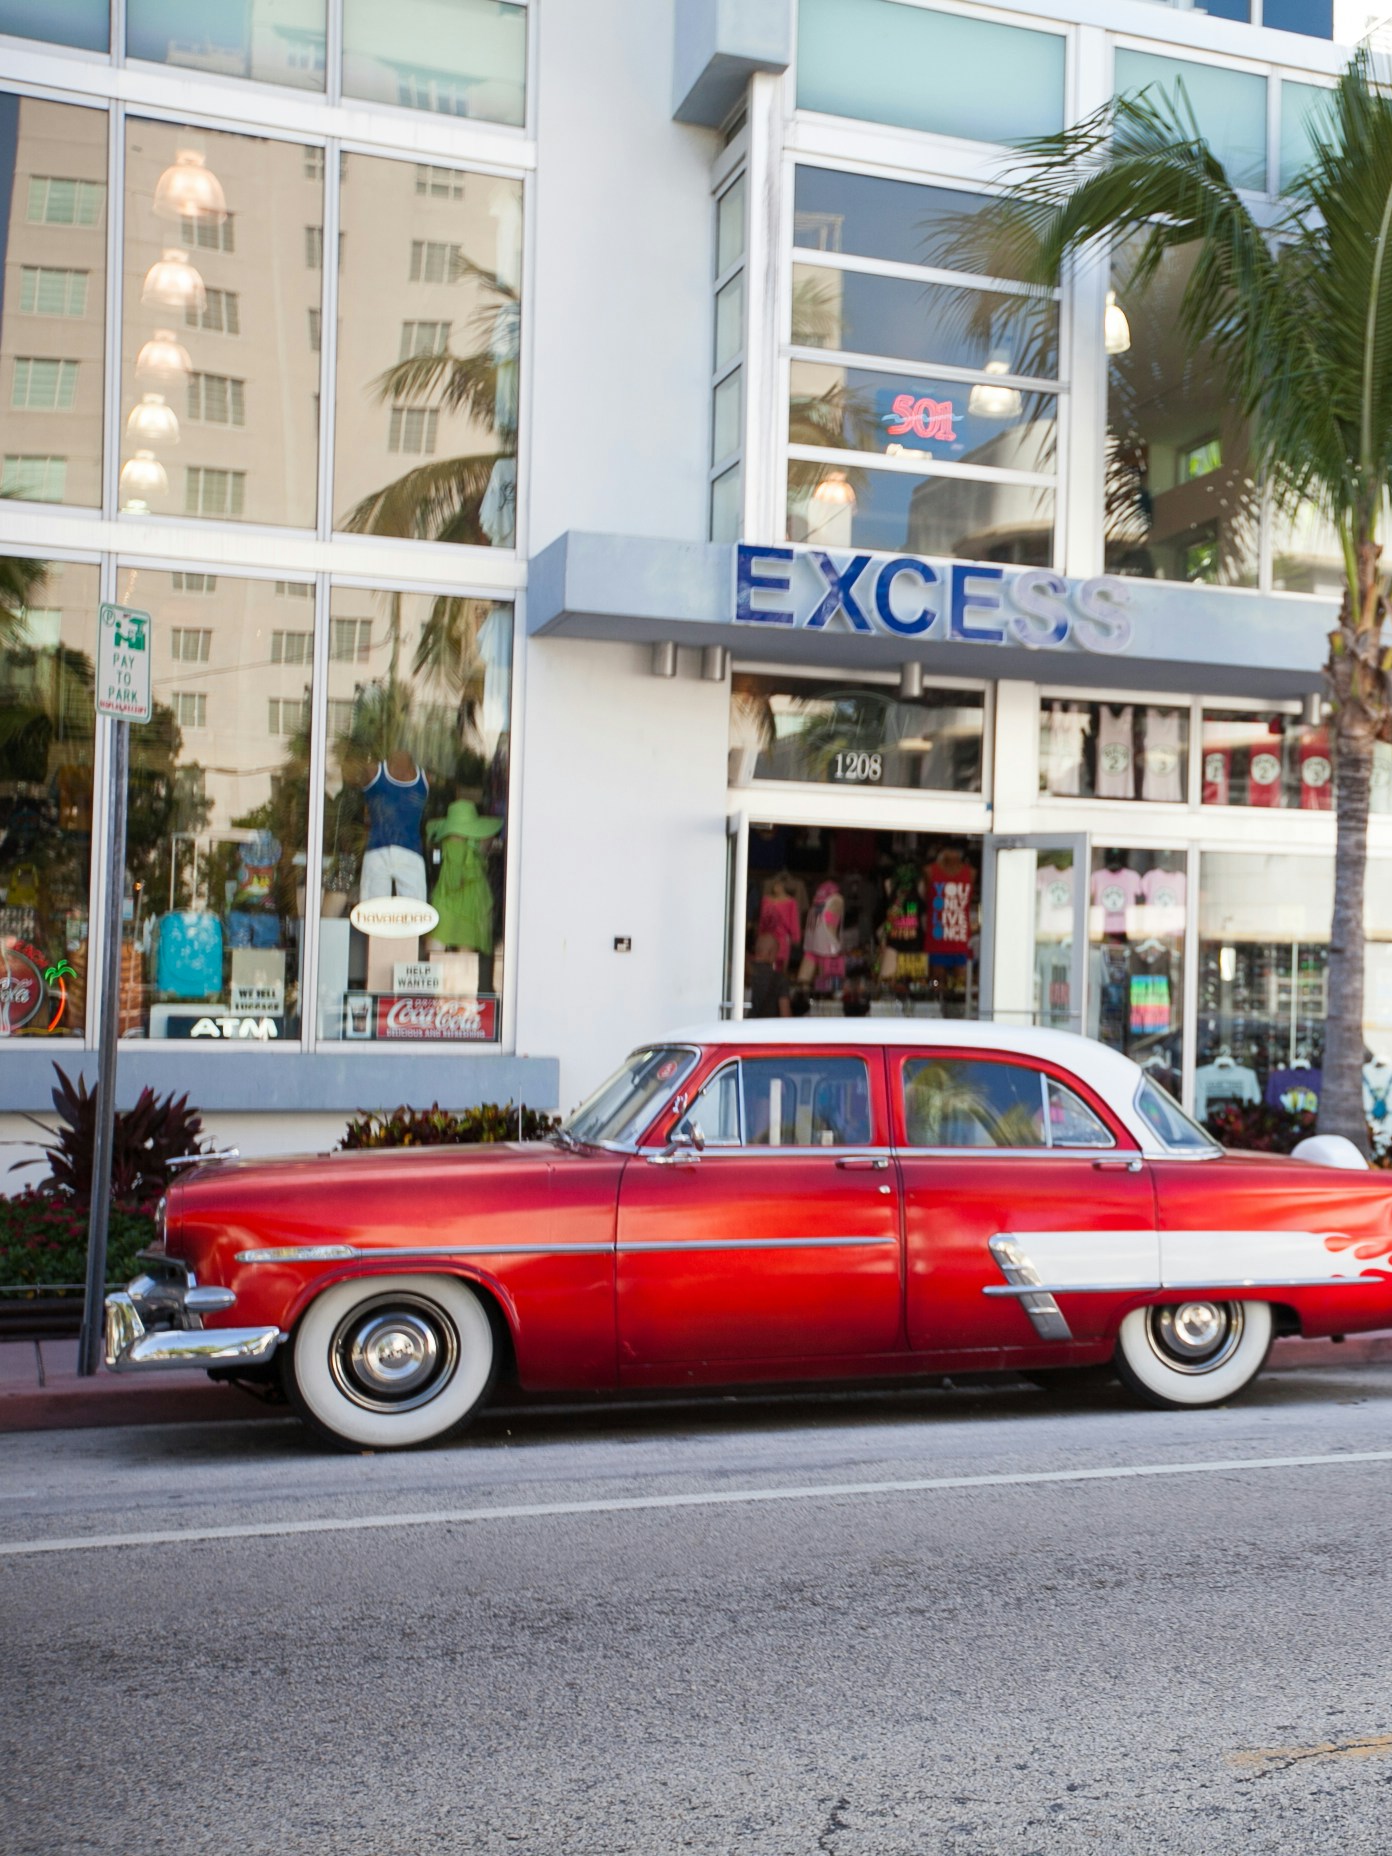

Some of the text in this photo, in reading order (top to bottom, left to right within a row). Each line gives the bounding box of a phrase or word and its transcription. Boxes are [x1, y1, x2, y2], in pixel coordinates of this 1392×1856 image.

[887, 394, 957, 441] 501
[732, 543, 1134, 654] EXCESS
[113, 652, 135, 670] PAY
[117, 670, 131, 687] TO
[108, 685, 138, 703] PARK
[834, 752, 882, 782] 1208
[933, 882, 971, 897] YOU
[932, 910, 968, 926] LIVE
[406, 966, 431, 975] HELP
[398, 977, 439, 988] WANTED
[191, 1018, 278, 1037] ATM
